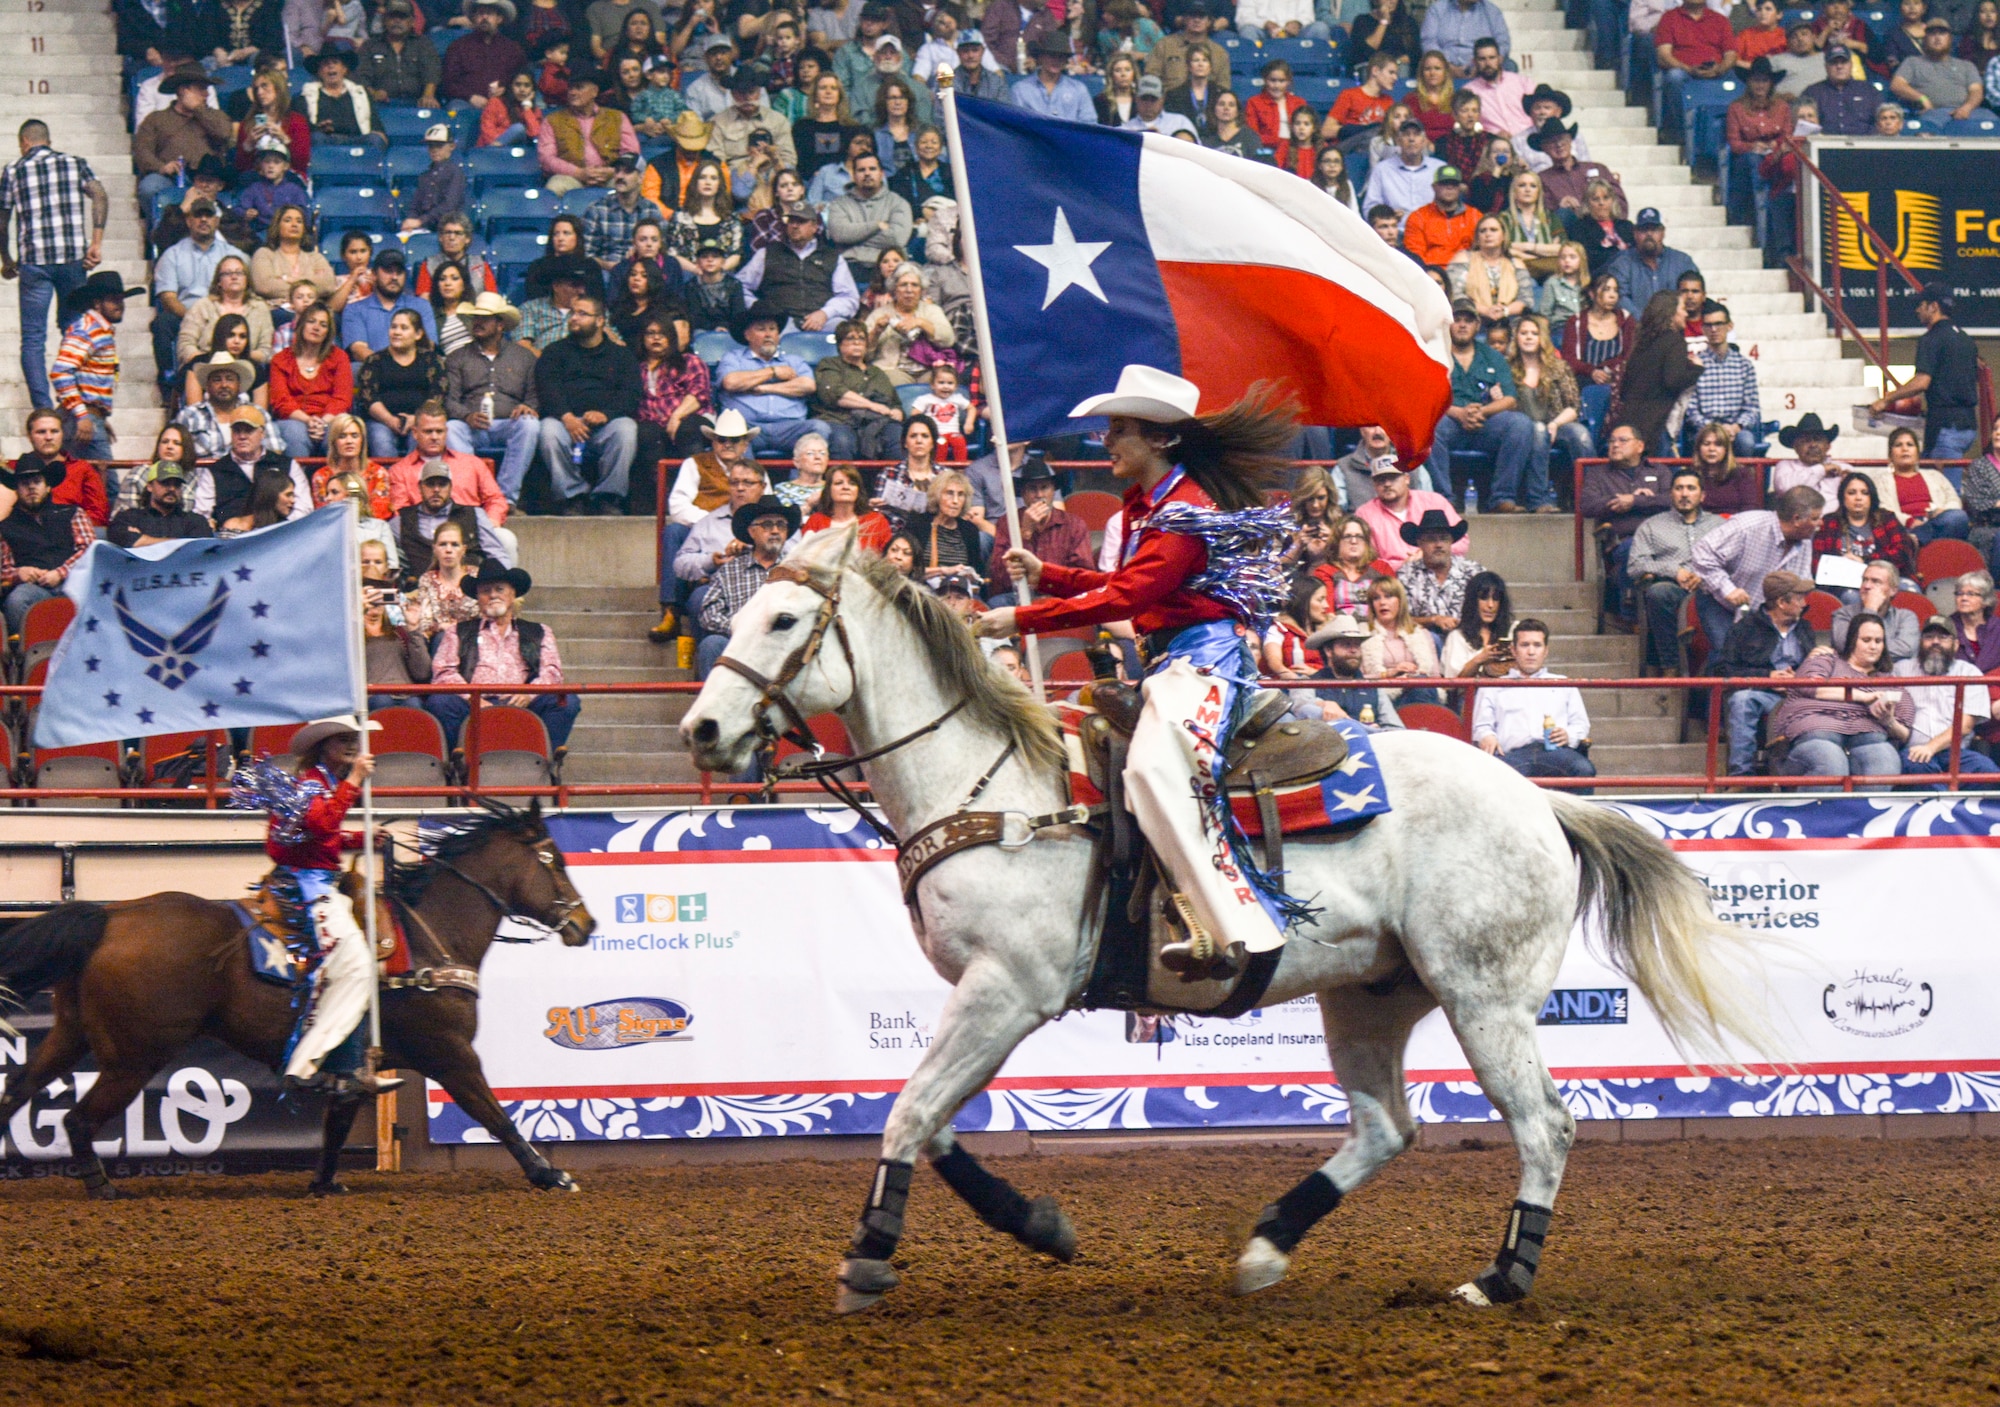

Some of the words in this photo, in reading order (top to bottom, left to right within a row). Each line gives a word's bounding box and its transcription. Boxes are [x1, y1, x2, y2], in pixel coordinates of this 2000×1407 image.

[31, 37, 44, 52] 11
[1521, 54, 1533, 69] 11
[29, 80, 49, 94] 10
[1749, 344, 1759, 361] 4
[1785, 393, 1796, 410] 3
[1717, 906, 1820, 929] ervices
[589, 933, 690, 951] TimeClock
[1842, 966, 1913, 994] Housley
[1614, 996, 1626, 1018] INK
[617, 1008, 688, 1041] Signs
[869, 1011, 917, 1029] Bank
[869, 1031, 902, 1049] San
[1184, 1034, 1209, 1046] Lisa
[1213, 1033, 1274, 1047] Copeland
